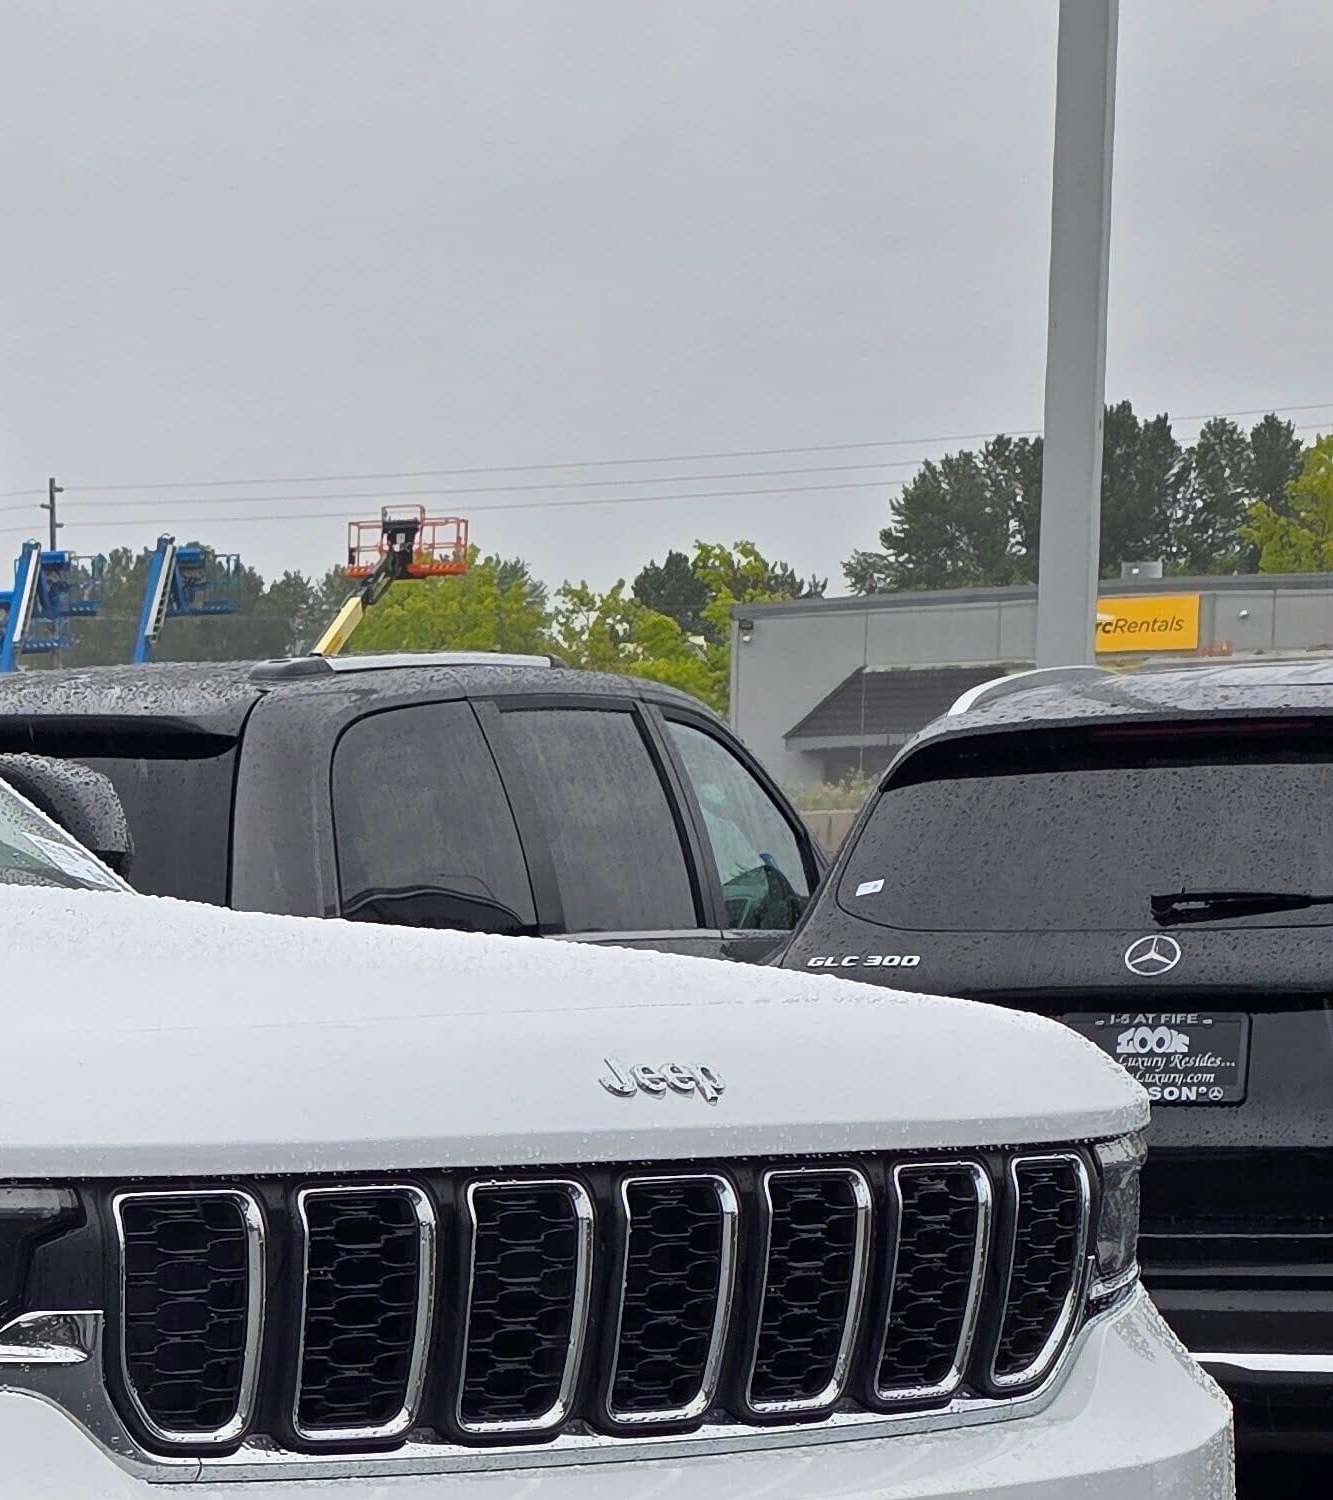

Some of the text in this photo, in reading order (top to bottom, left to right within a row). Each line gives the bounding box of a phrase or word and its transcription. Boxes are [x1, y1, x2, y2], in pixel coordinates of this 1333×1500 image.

[807, 956, 921, 967] GLC 300
[1134, 1013, 1157, 1025] AT
[1160, 1013, 1199, 1025] FIFE
[598, 1054, 727, 1106] Jeep
